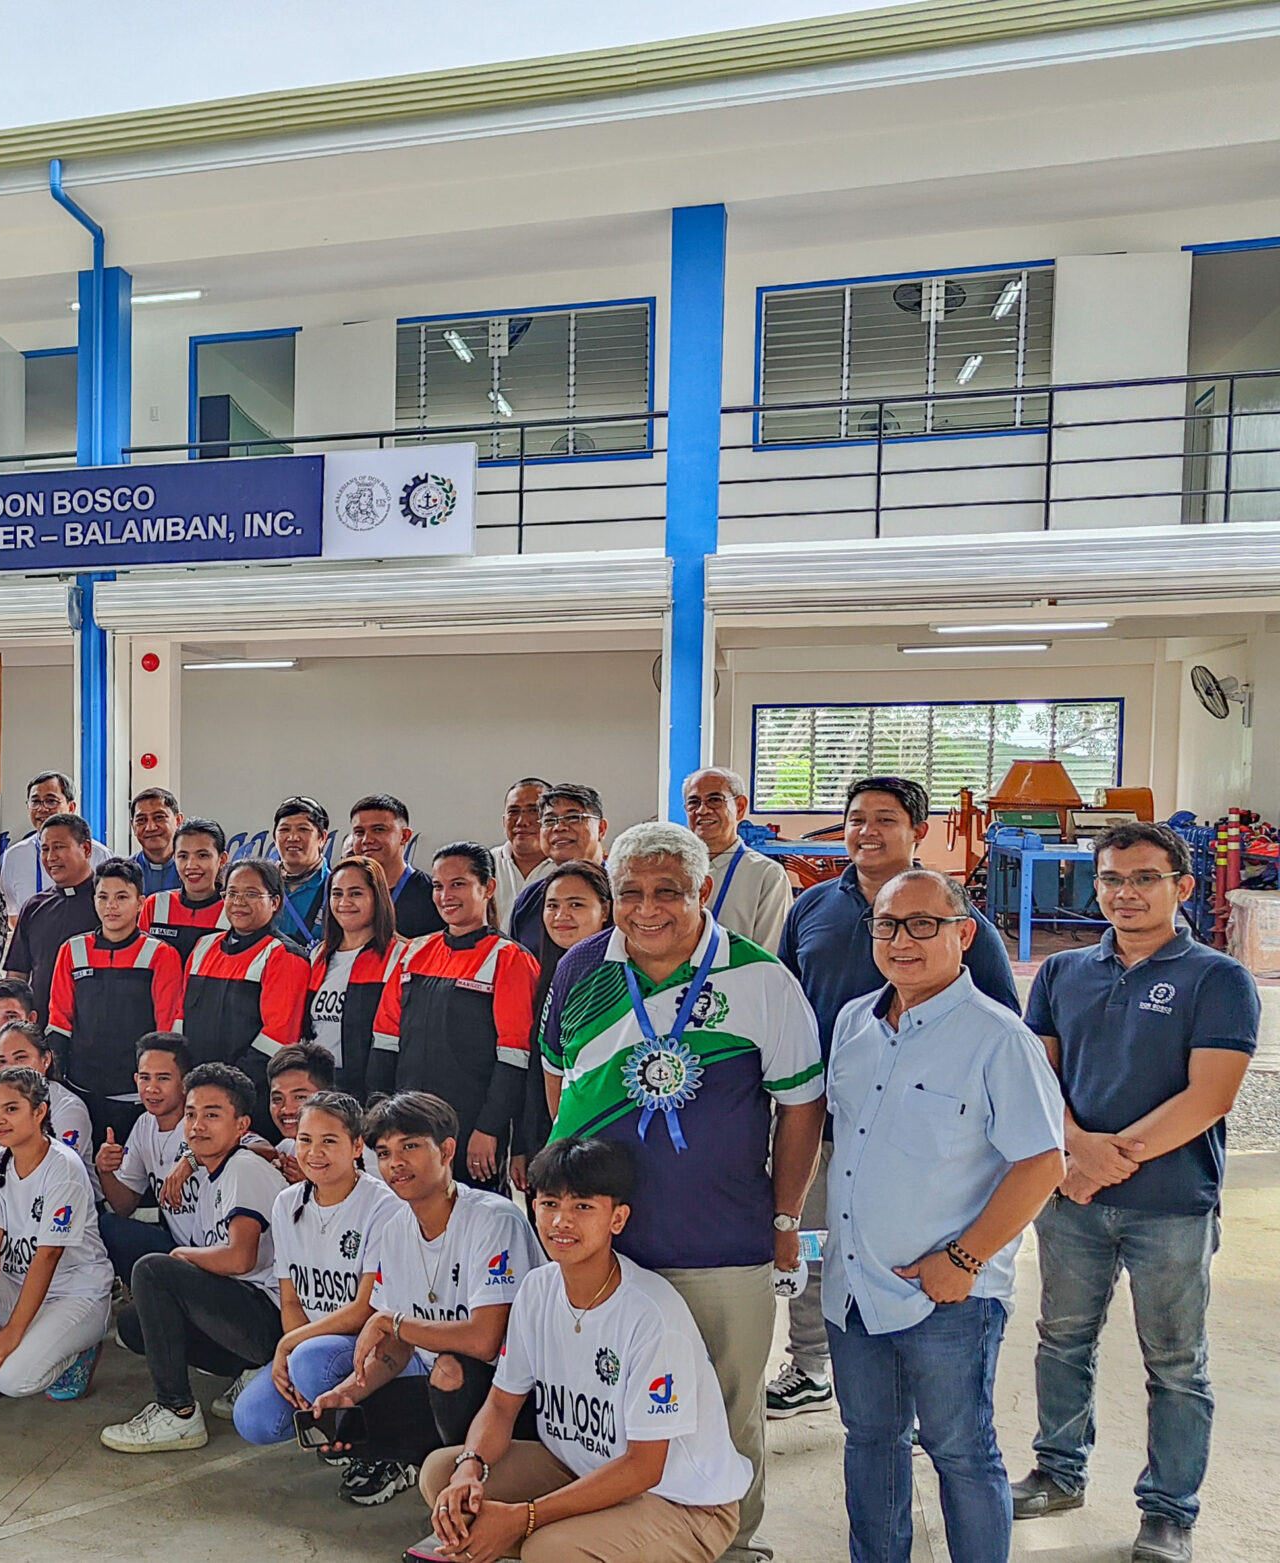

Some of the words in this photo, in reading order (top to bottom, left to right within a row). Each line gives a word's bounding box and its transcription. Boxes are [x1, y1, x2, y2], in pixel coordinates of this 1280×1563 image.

[53, 486, 155, 515] BOSCO
[64, 514, 235, 547] BALAMBAN,
[243, 511, 303, 538] INC.
[314, 990, 347, 1014] BOS
[288, 1263, 310, 1297] ON
[485, 1275, 516, 1286] JARC
[647, 1402, 679, 1415] JARC
